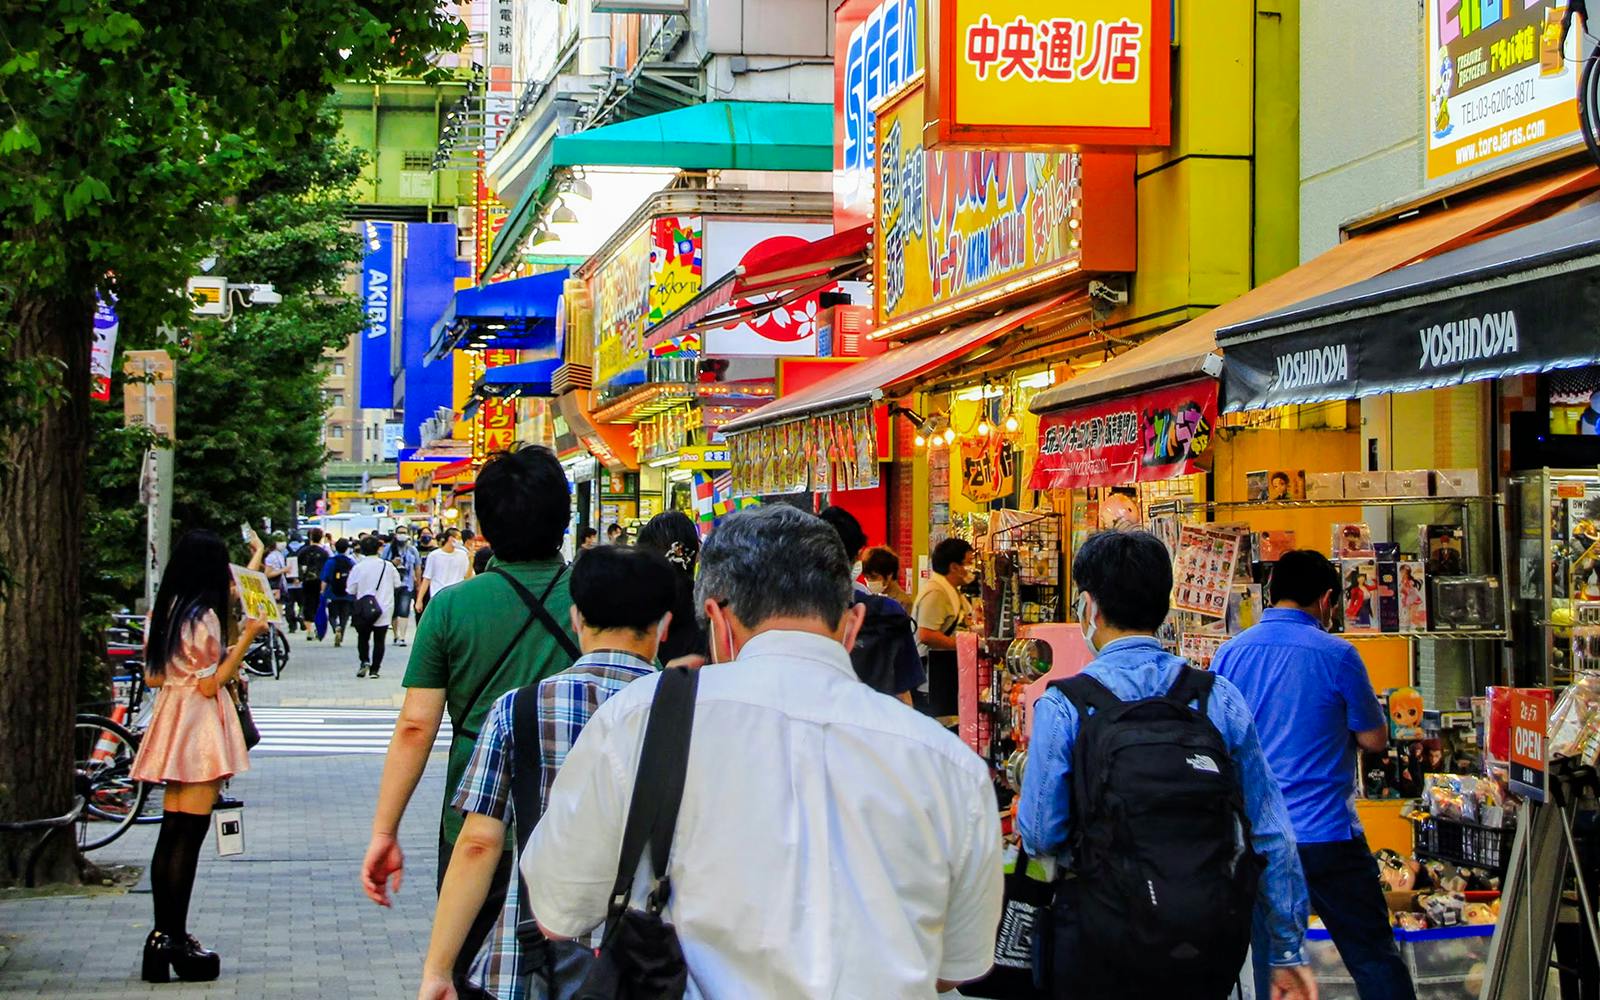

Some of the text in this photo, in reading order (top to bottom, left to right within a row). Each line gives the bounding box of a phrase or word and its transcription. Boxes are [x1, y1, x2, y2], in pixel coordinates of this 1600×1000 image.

[967, 16, 1142, 84] 中央通り店
[844, 0, 917, 172] SEGA
[1461, 78, 1536, 126] TEL:03-6206-8871
[1455, 119, 1546, 165] www.torejaras.com
[368, 268, 389, 339] AKIBA
[1419, 310, 1518, 370] YOSHINOYA
[1275, 345, 1349, 390] YOSHINOYA
[1515, 727, 1541, 761] OPEN
